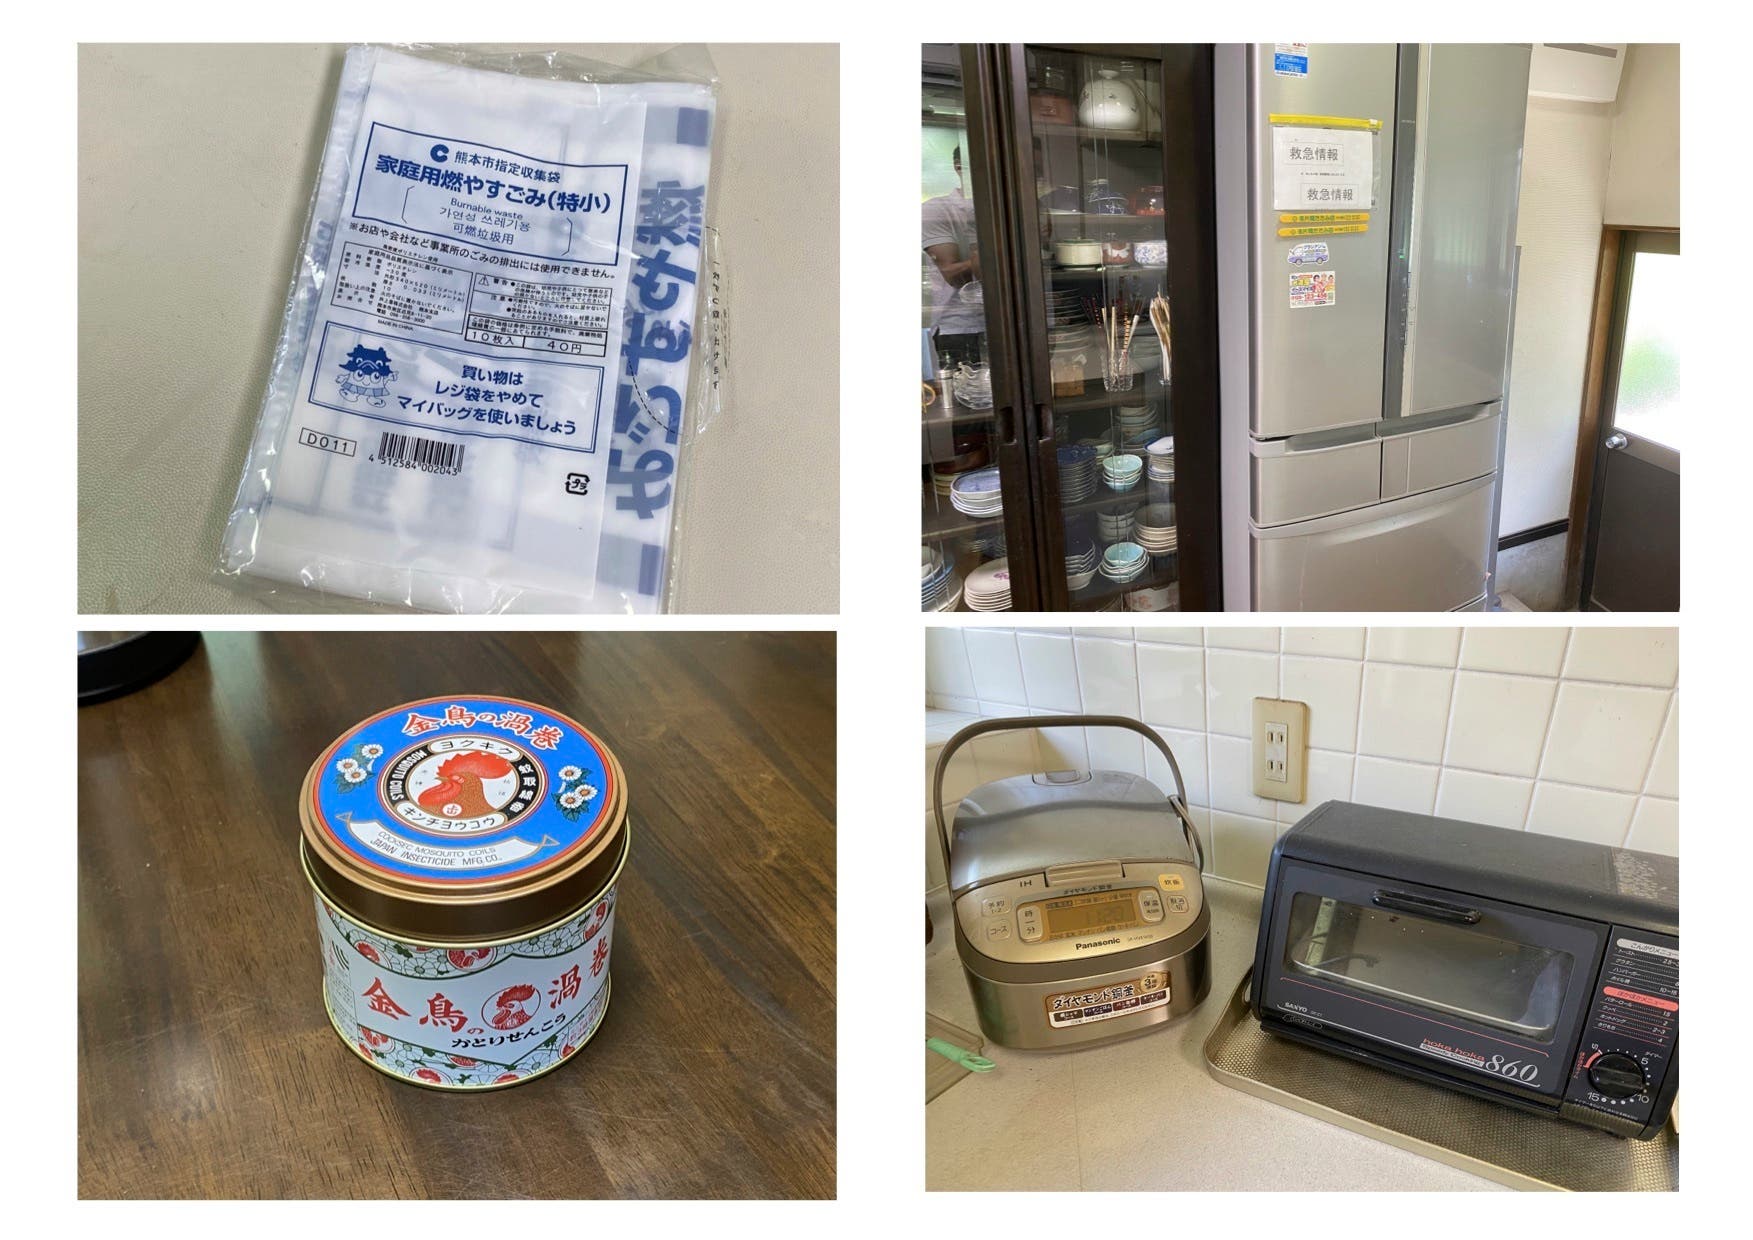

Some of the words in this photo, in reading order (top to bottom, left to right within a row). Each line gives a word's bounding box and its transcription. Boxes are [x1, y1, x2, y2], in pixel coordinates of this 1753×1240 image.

[1289, 146, 1338, 161] 救急情報
[454, 150, 561, 184] 熊本市指定収集袋
[376, 154, 611, 214] 家庭用燃やすごみ(特小)
[1307, 188, 1353, 202] 救急情報
[440, 207, 476, 229] 가연성
[481, 214, 530, 232] 쓰레기용
[450, 197, 492, 218] Burnable
[494, 208, 523, 220] waste
[453, 221, 514, 245] 可燃垃圾用
[472, 331, 514, 345] 10枚入
[547, 341, 582, 354] 40円
[461, 364, 523, 386] 買い物は
[435, 381, 544, 408] レジ袋をやめて
[397, 395, 576, 436] マイバッグを使いましょう
[368, 454, 375, 463] 4
[381, 457, 417, 470] 512584
[421, 464, 458, 477] 002043
[571, 478, 588, 490] プラ
[402, 705, 564, 751] 金鳥の渦巻
[439, 739, 514, 755] ヨクキク
[389, 778, 405, 801] COILS
[370, 838, 399, 855] JAPAN
[401, 850, 456, 867] INSECTICIDE
[414, 846, 464, 858] MOSQUITO
[469, 848, 497, 857] COILS
[1019, 879, 1033, 888] IH
[990, 926, 1008, 936] コース
[1075, 936, 1121, 950] Panasonic
[1053, 985, 1134, 1009] ダイヤモンド銅釜
[1284, 1002, 1308, 1012] SANYO
[452, 1013, 566, 1049] かとりせんこう
[1422, 1037, 1453, 1052] hoka
[1455, 1047, 1486, 1061] hoka
[1485, 1055, 1538, 1082] 860
[1641, 1057, 1649, 1065] 5
[1588, 1092, 1600, 1102] 15
[1637, 1094, 1650, 1103] 10
